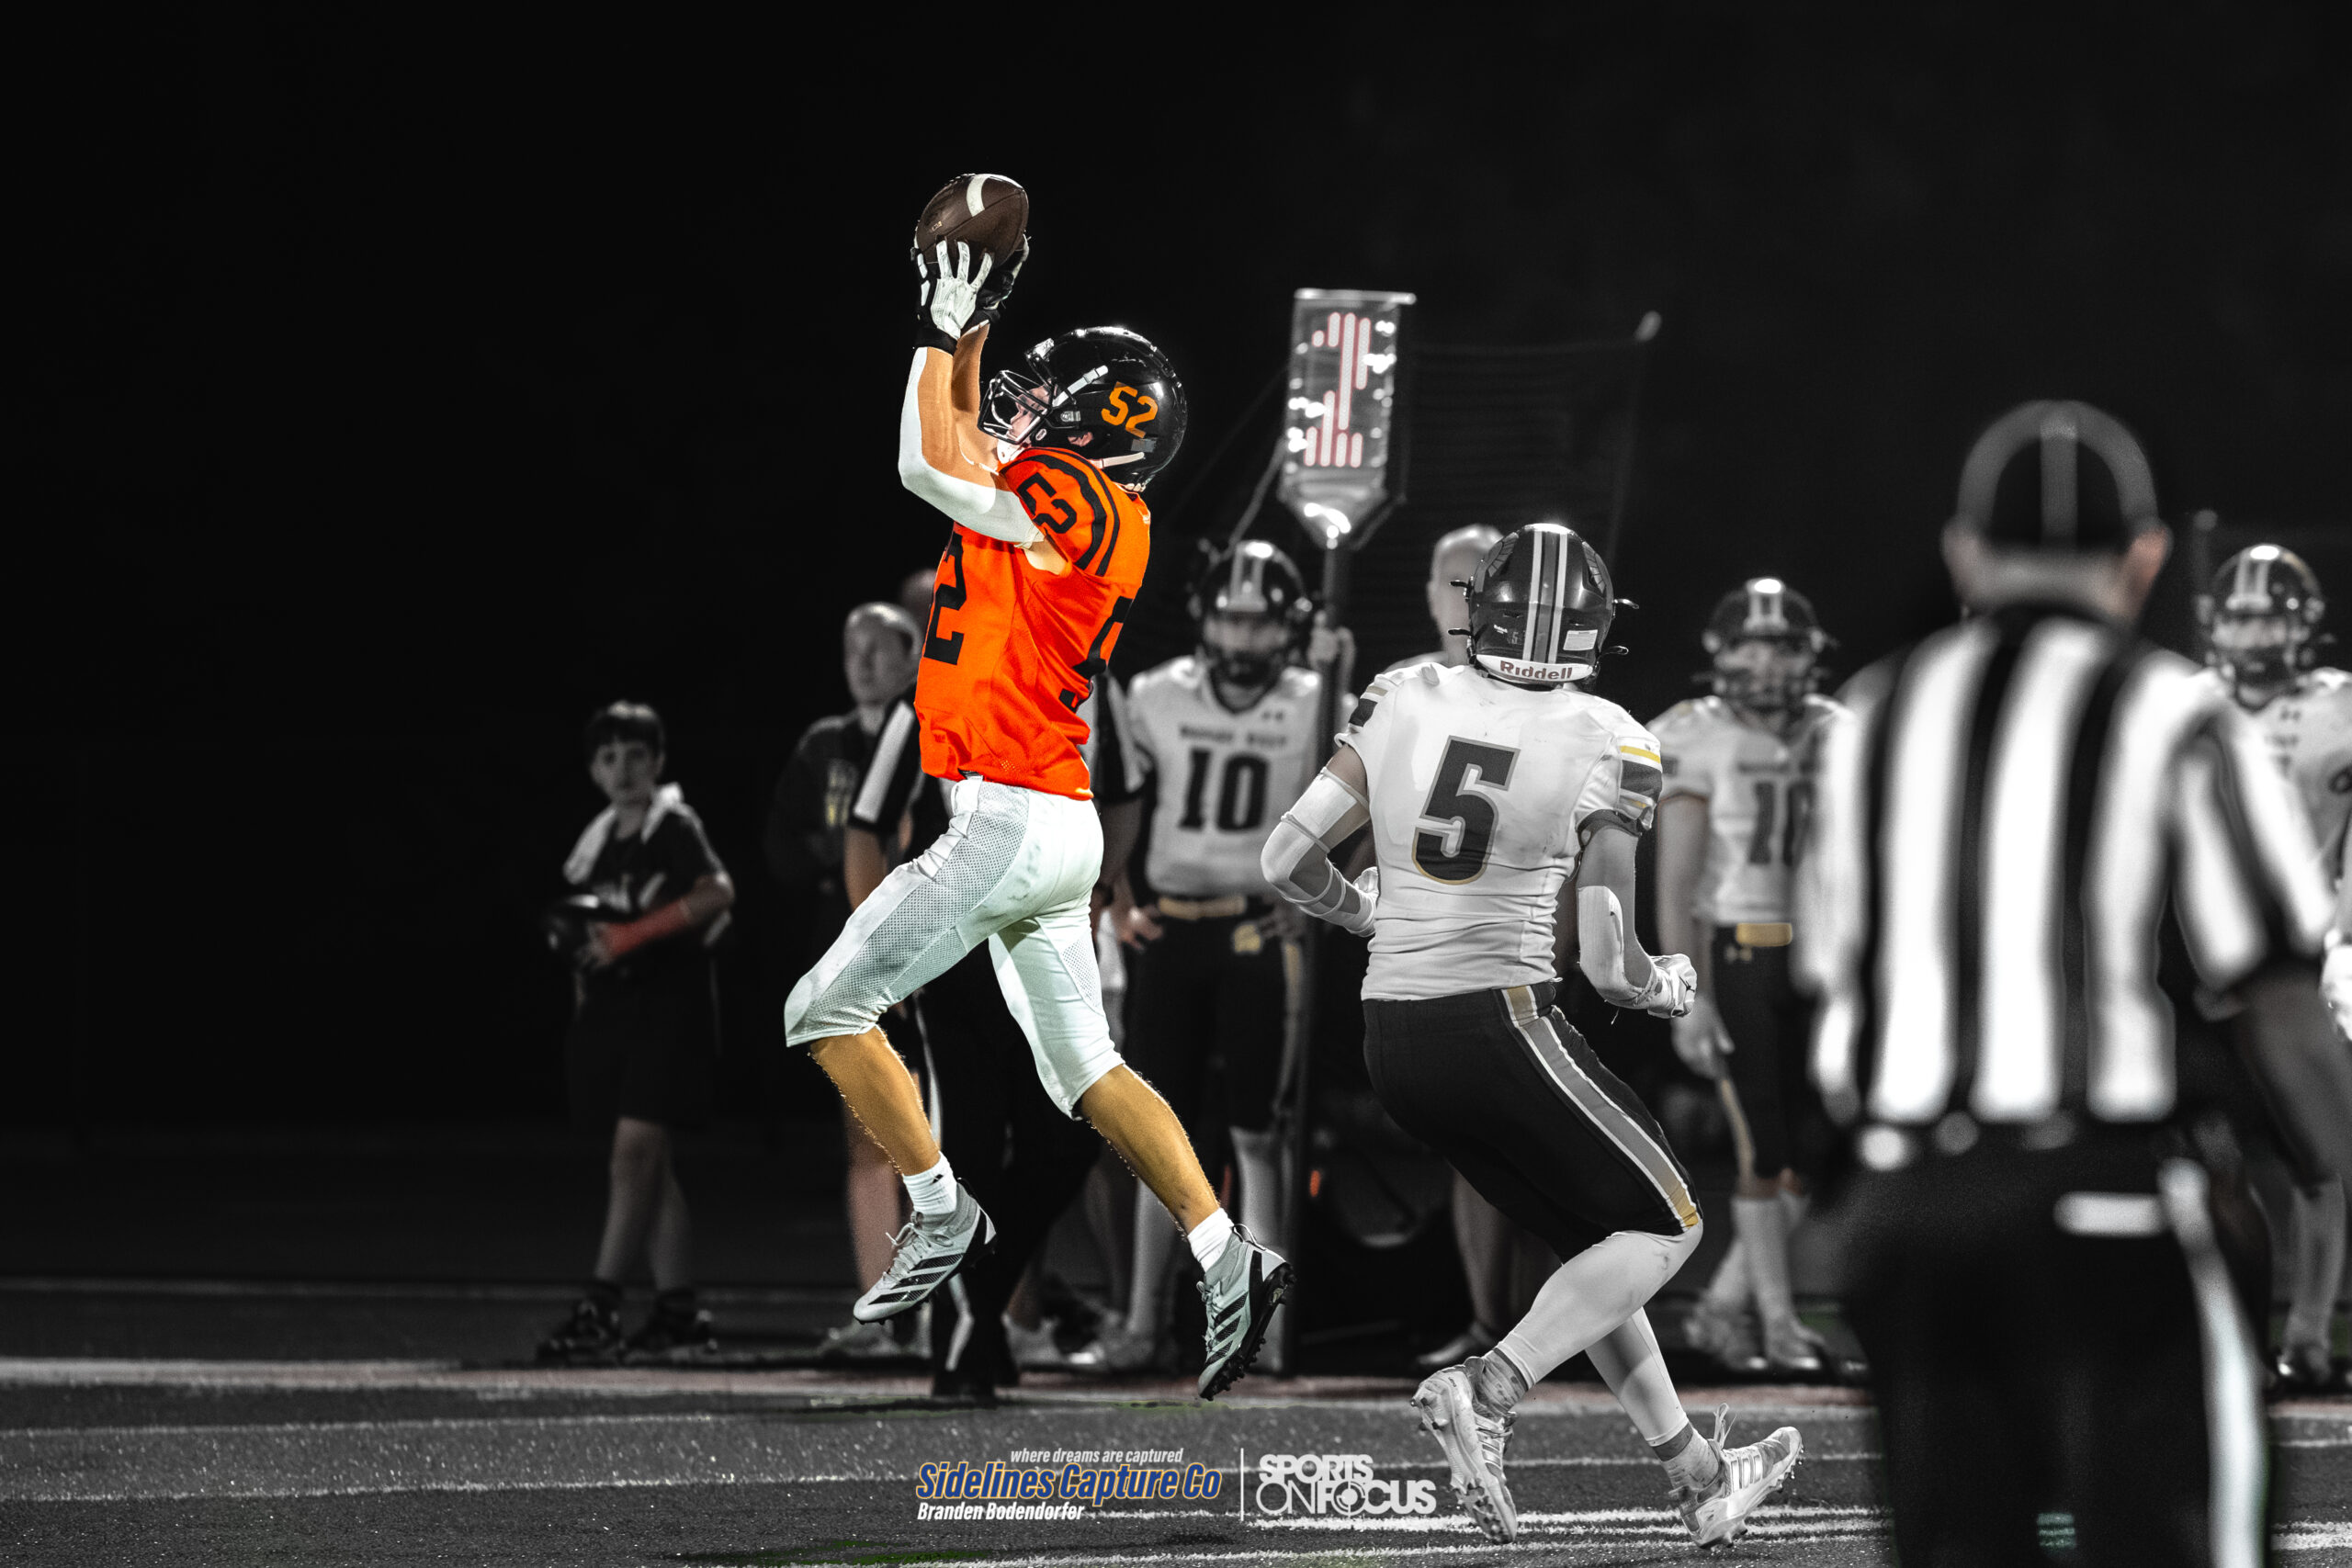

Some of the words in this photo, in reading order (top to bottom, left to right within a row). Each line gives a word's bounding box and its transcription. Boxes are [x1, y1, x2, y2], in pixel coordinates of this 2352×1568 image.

[1102, 381, 1159, 439] 52
[1499, 660, 1573, 680] Riddell
[1177, 750, 1271, 833] 10
[1411, 735, 1521, 886] 5
